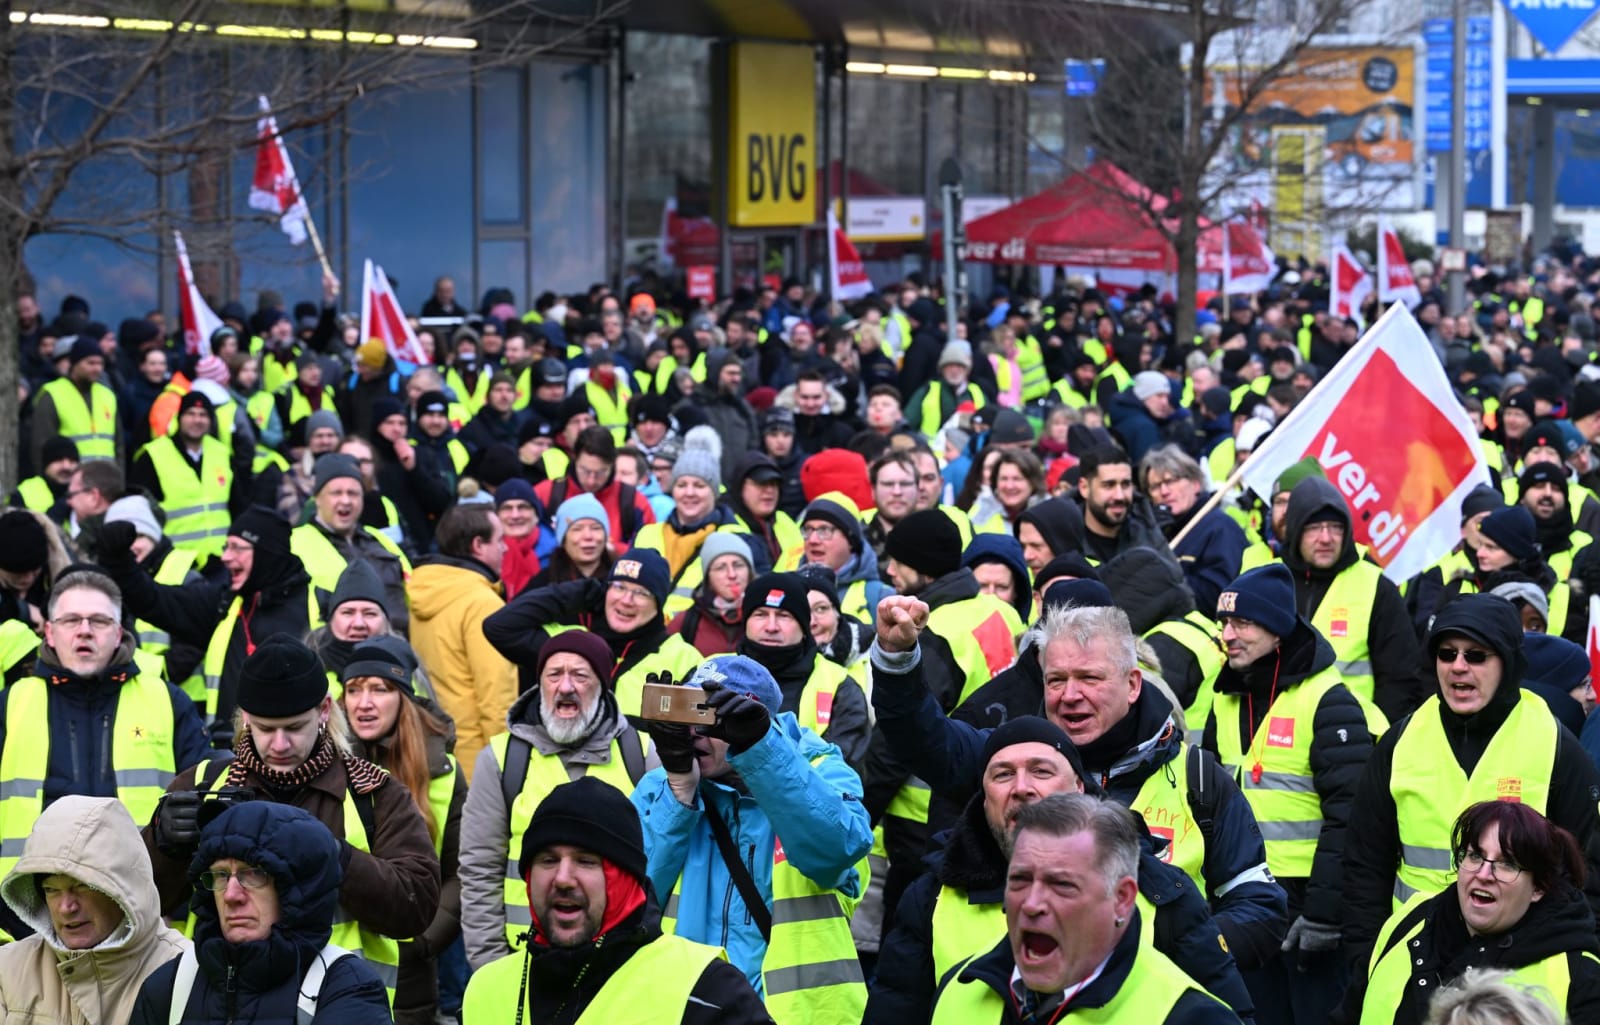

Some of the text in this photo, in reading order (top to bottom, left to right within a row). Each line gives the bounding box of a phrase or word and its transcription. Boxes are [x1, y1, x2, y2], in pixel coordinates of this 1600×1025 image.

[748, 133, 806, 203] BVG
[1319, 431, 1407, 558] ver.di
[1268, 732, 1293, 745] ver.di
[1143, 806, 1194, 844] enry
